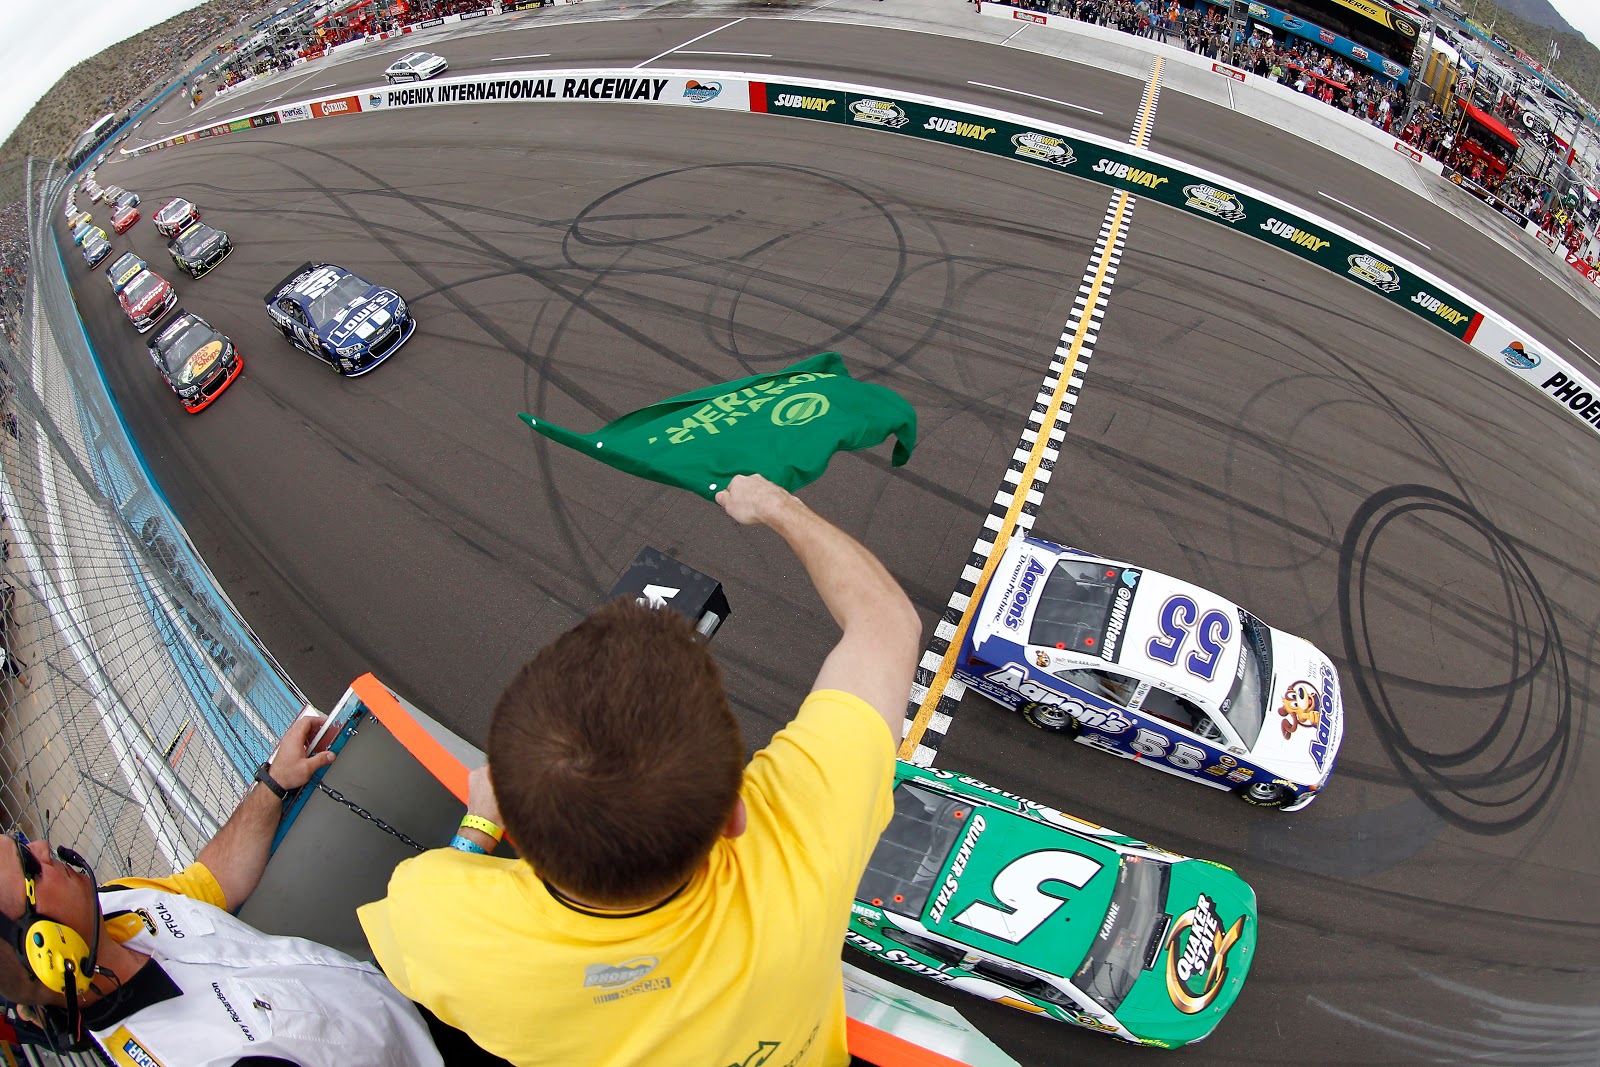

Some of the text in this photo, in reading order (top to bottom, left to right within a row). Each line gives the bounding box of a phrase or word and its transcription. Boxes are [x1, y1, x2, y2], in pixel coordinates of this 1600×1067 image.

[388, 87, 434, 106] PHOENIX
[438, 79, 556, 103] INTERNATIONAL
[562, 78, 669, 101] RACEWAY
[774, 94, 836, 112] SUBWAY
[860, 100, 896, 111] SUBWAY
[923, 116, 997, 141] SUBWAY
[1025, 131, 1065, 147] SUBWAY
[1092, 158, 1169, 190] SUBWAY
[1197, 183, 1236, 202] SUBWAY
[1484, 195, 1495, 206] 14
[1555, 209, 1568, 225] 14
[1260, 217, 1330, 252] SUBWAY
[1360, 254, 1394, 273] SUBWAY
[334, 294, 390, 338] LOWE'S
[1411, 291, 1469, 325] SUBWAY
[994, 554, 1028, 622] Dream Machine
[1004, 556, 1046, 630] Aaron's
[1101, 587, 1131, 663] @MWRteam
[1146, 594, 1232, 682] 55
[1236, 644, 1248, 681] MARTIN
[985, 664, 1131, 733] Aaron's
[1310, 663, 1335, 773] Aaron's
[1130, 728, 1207, 771] 55
[929, 814, 987, 925] QUAKER STATE
[952, 848, 1105, 945] 5
[1100, 901, 1120, 941] KAHNE
[1177, 893, 1210, 981] QUAKER
[1194, 913, 1218, 976] STATE
[877, 949, 954, 983] STATE
[211, 982, 242, 1023] Richardson
[619, 977, 668, 998] NASCAR
